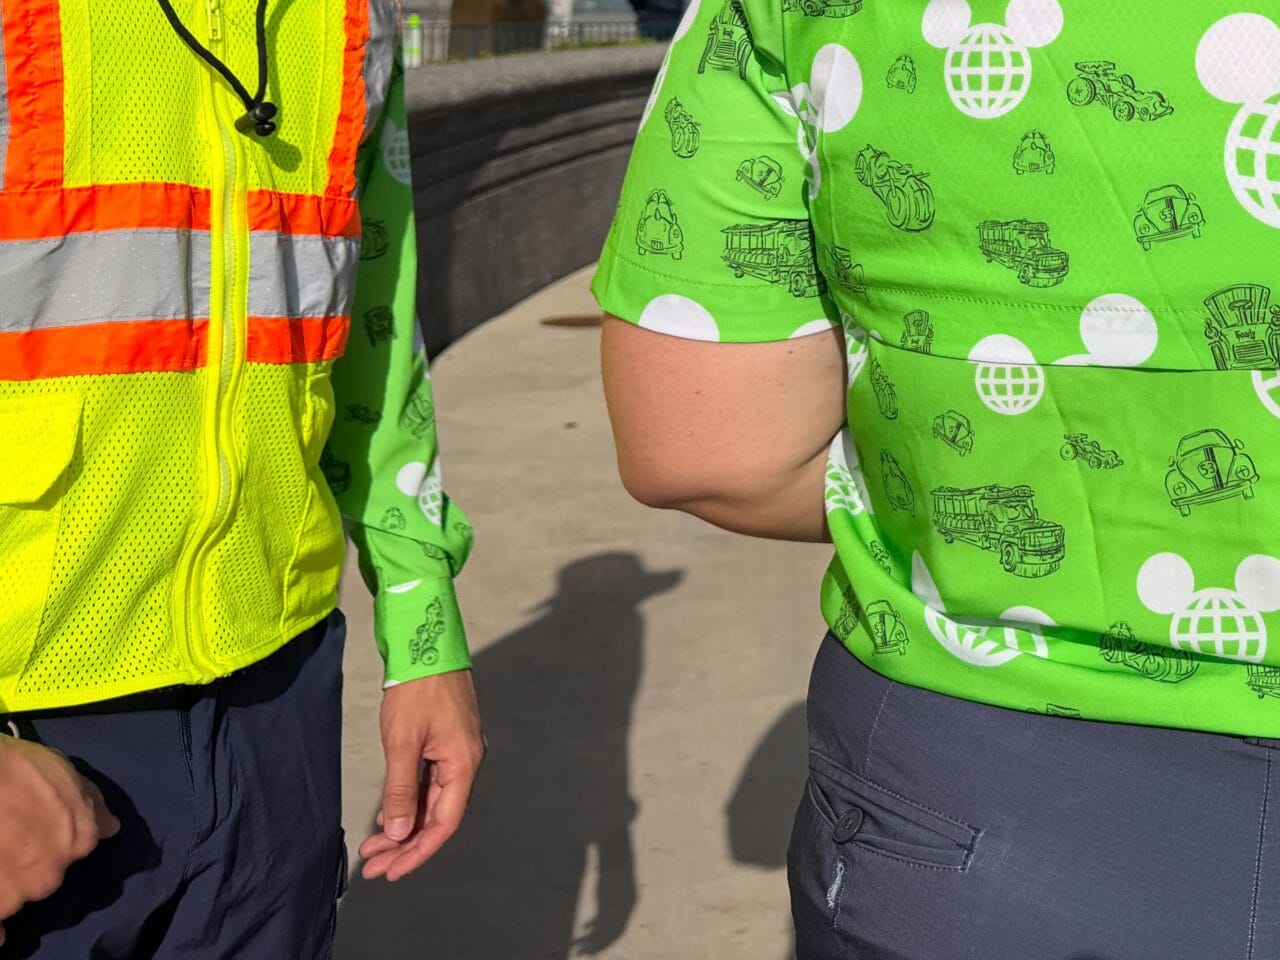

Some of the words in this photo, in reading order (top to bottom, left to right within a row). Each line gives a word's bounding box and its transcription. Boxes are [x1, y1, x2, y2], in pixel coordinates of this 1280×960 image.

[1161, 209, 1173, 220] 53
[1200, 462, 1216, 476] 53
[874, 623, 884, 635] 53
